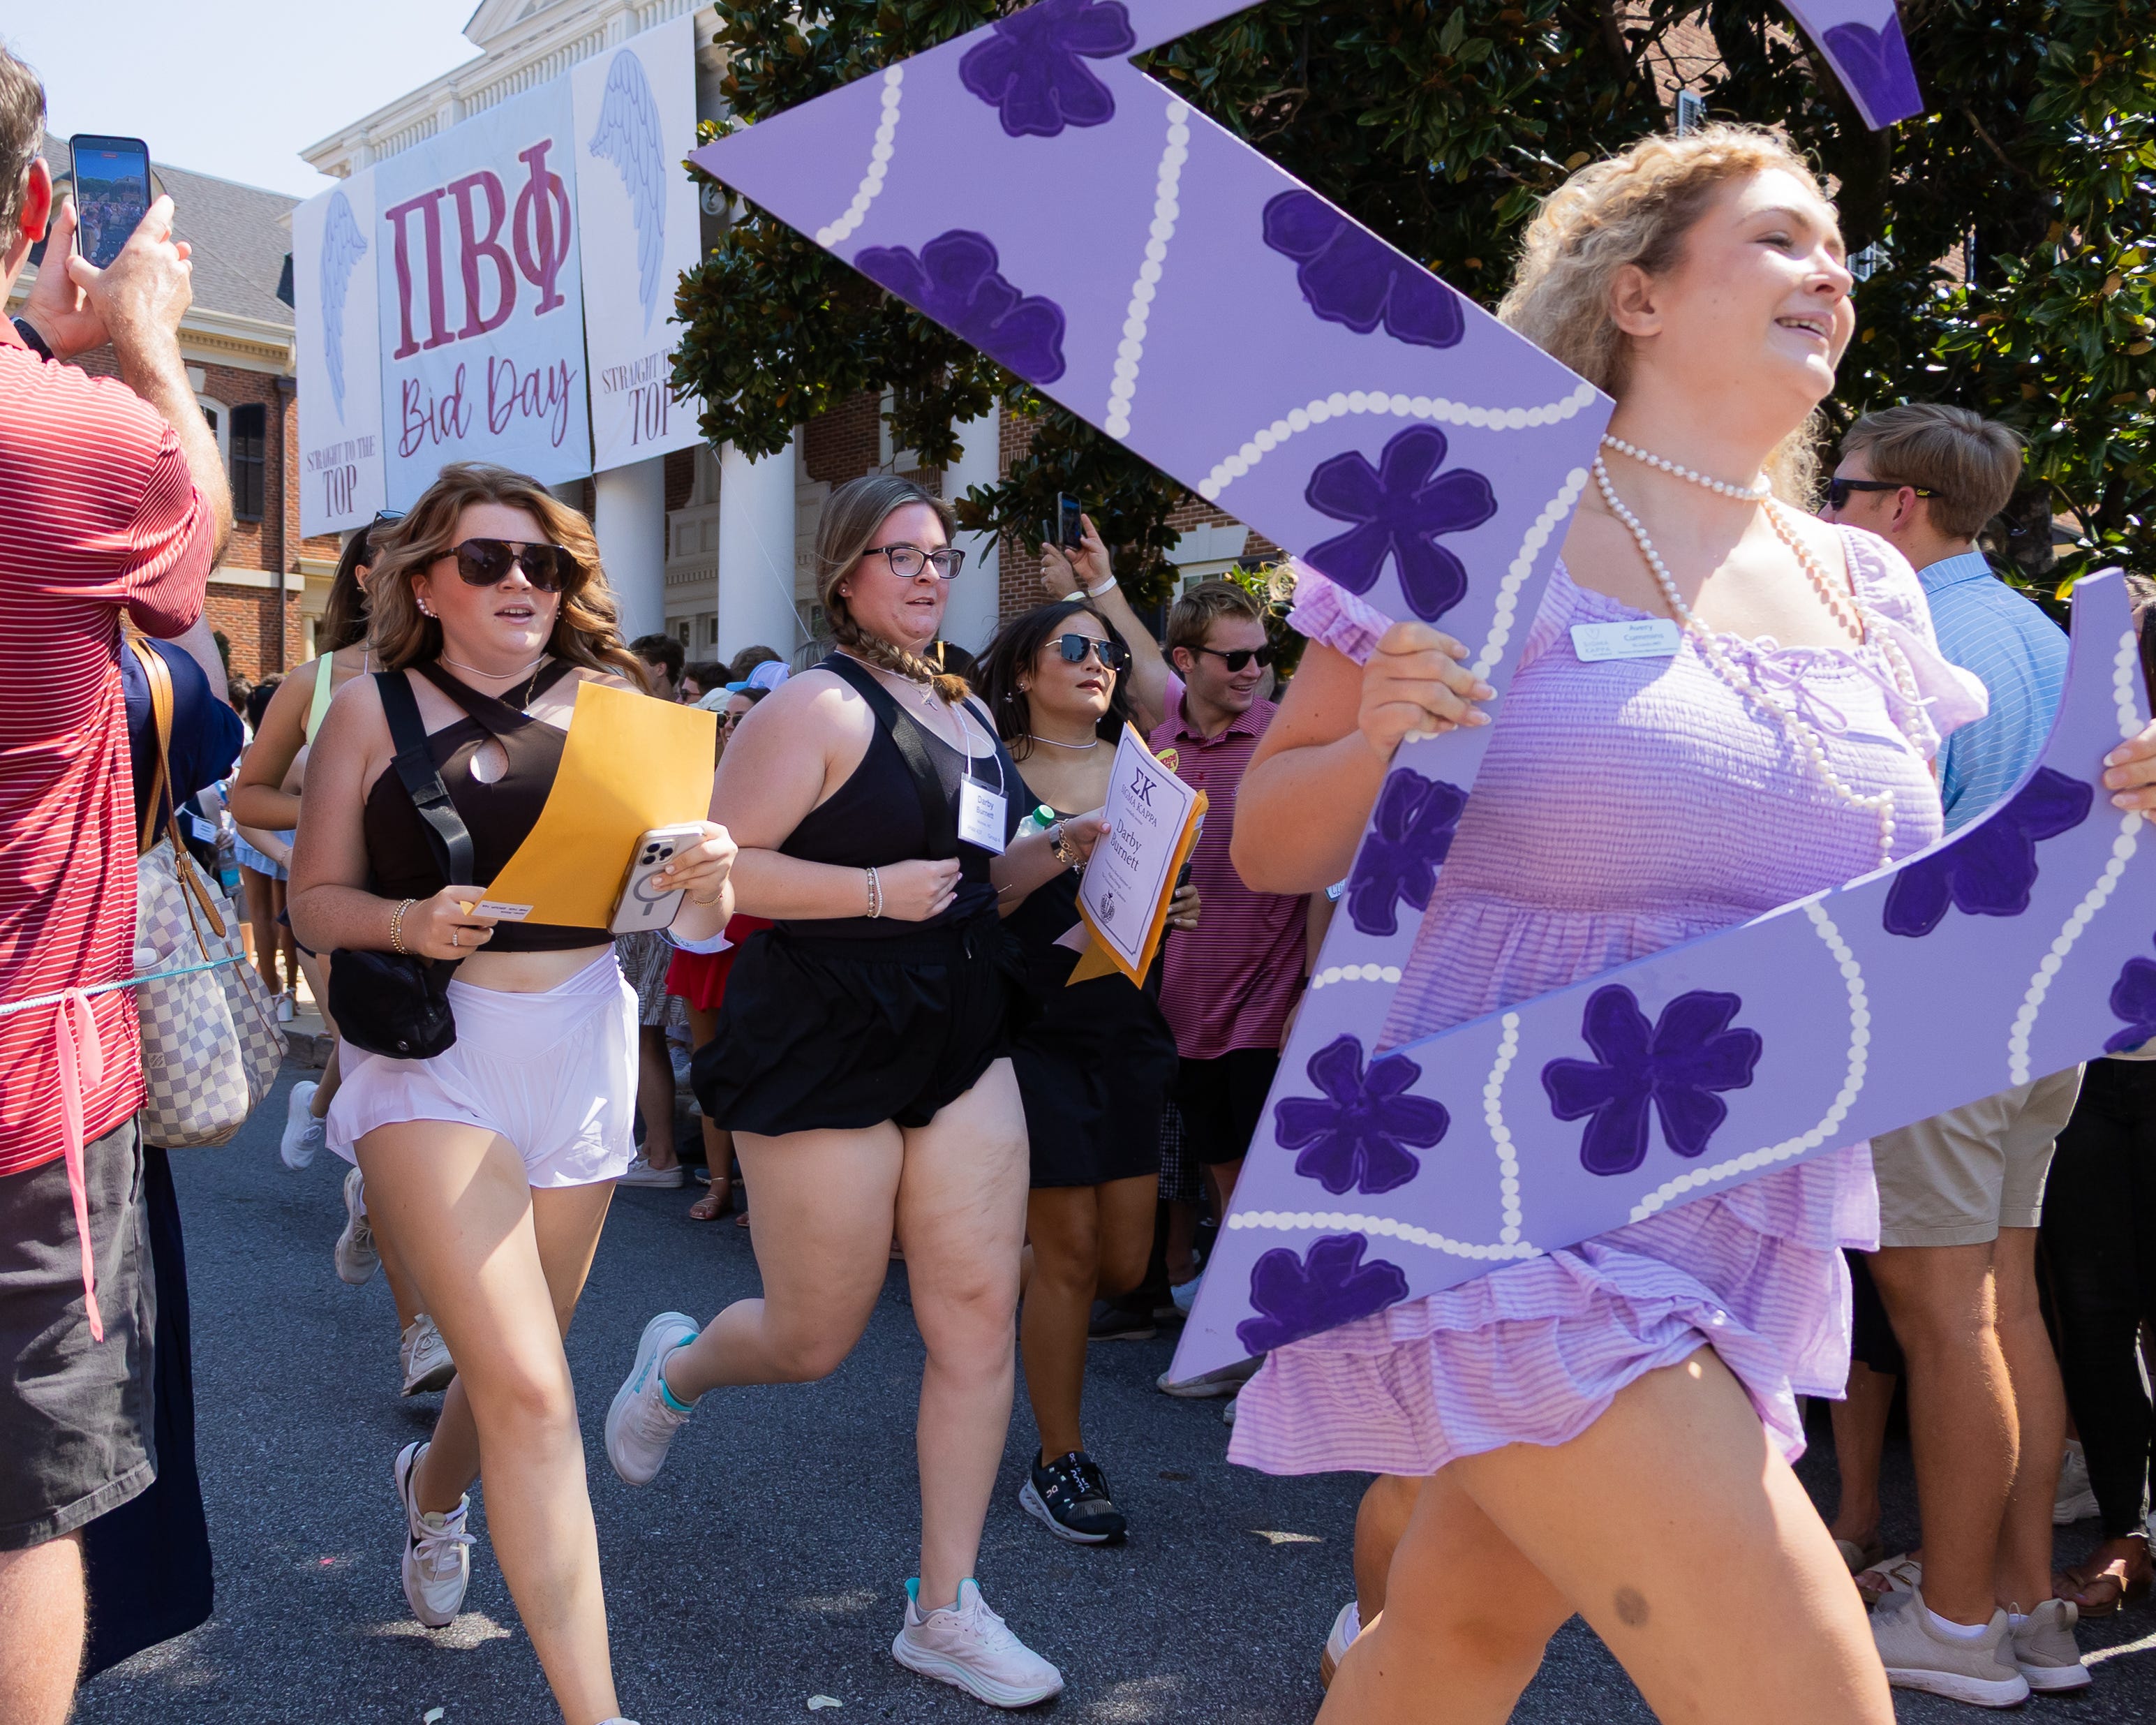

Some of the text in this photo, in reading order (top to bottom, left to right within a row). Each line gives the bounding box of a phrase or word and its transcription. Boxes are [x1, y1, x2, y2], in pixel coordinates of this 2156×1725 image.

[602, 353, 658, 394] STRAIGHT
[399, 355, 578, 458] Bid Day
[628, 377, 676, 446] TOP
[344, 440, 356, 461] TO
[357, 436, 376, 459] THE
[322, 464, 357, 517] TOP
[976, 806, 995, 820] Burnett
[978, 795, 995, 810] Darby
[1121, 784, 1136, 808] SIGMA
[1136, 802, 1157, 827] KAPPA
[1110, 831, 1140, 872] Burnett
[1117, 818, 1142, 854] Darby
